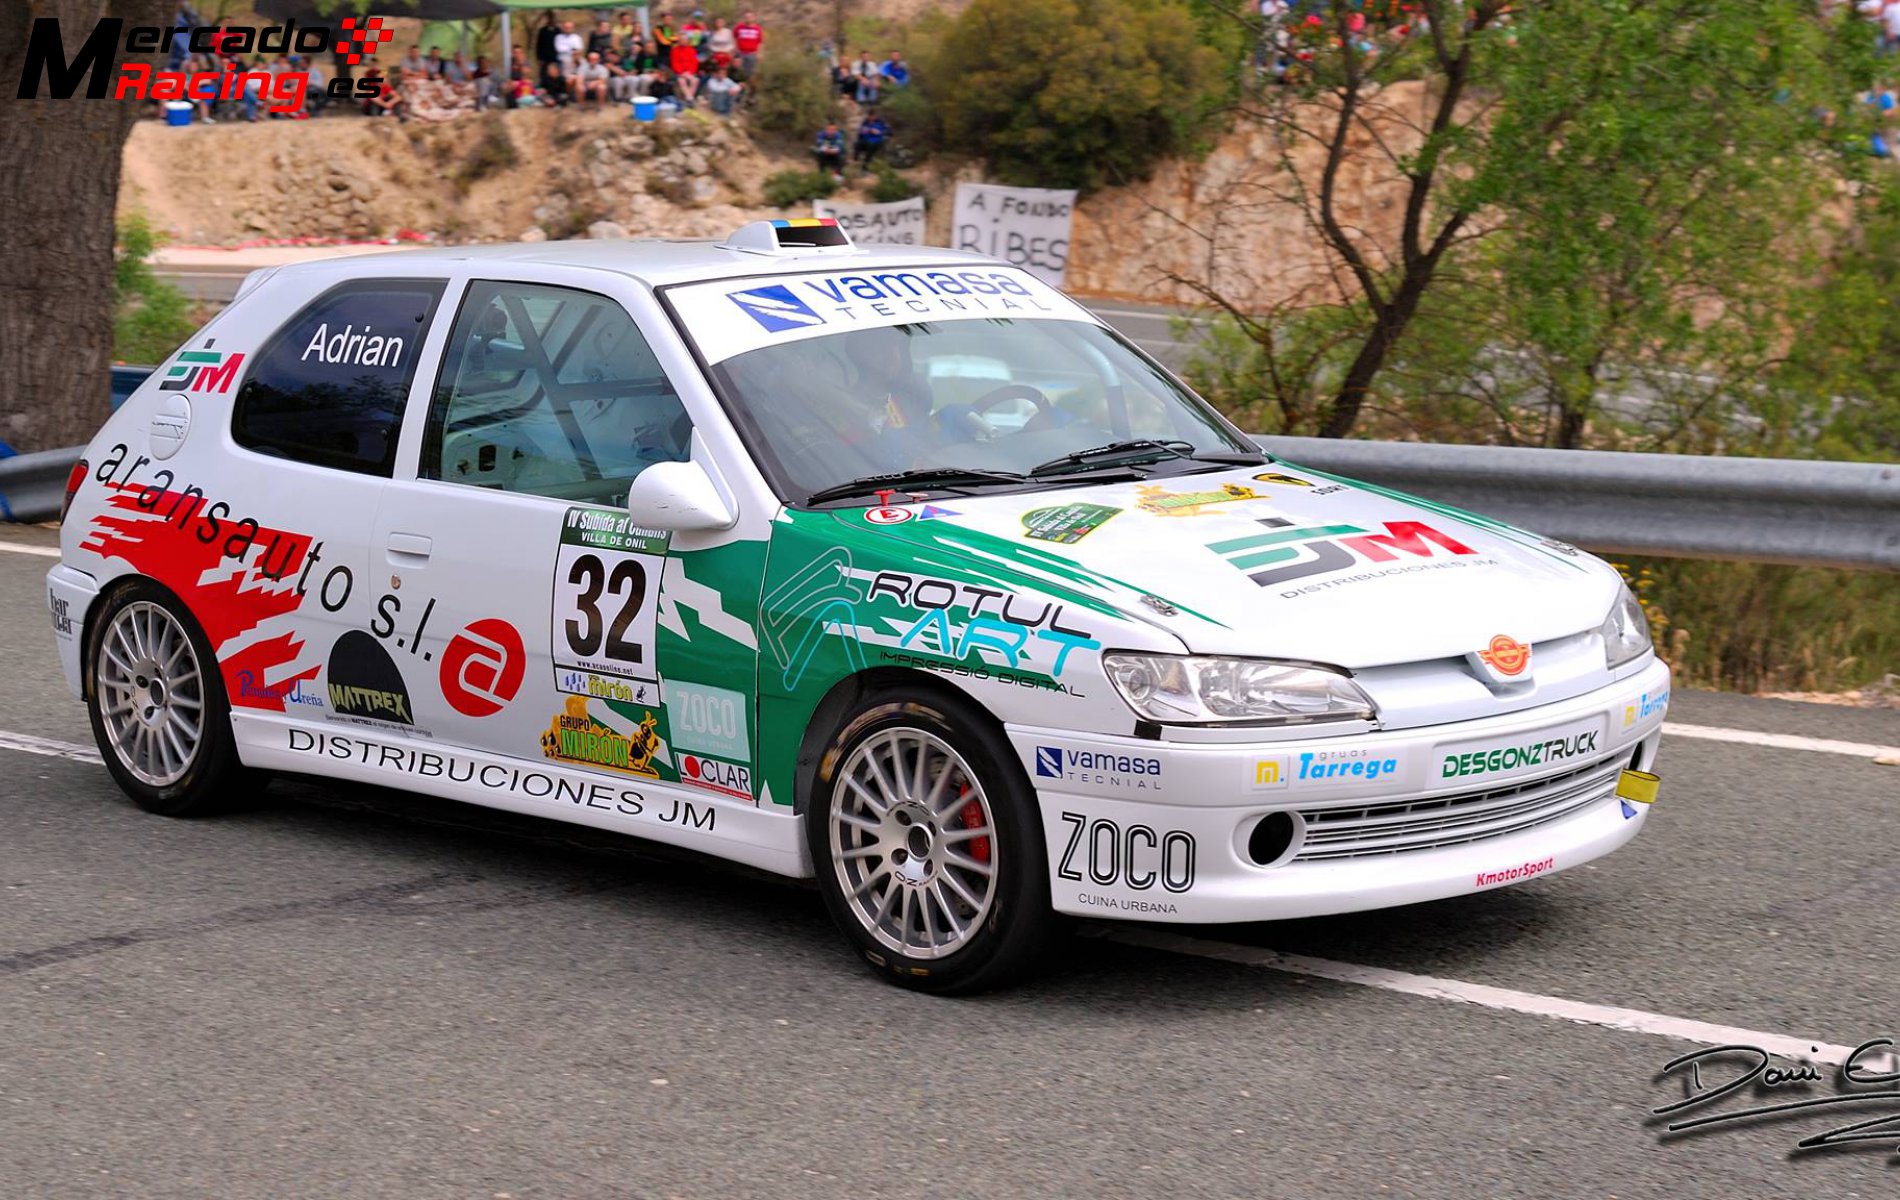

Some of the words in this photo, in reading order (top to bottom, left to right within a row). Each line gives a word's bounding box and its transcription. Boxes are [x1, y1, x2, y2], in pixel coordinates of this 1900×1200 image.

[803, 271, 1033, 304] vamasa
[834, 297, 1053, 321] TECNIAL
[302, 323, 403, 367] Adrian
[567, 510, 582, 528] IV
[580, 511, 616, 533] Subida
[95, 443, 353, 612] aransauto
[371, 594, 436, 662] s.l.
[581, 531, 607, 544] VILLA
[609, 535, 623, 546] DE
[625, 537, 647, 549] ONIL
[1280, 561, 1466, 599] DISTRIBUCIONES
[564, 553, 647, 664] 32
[868, 572, 1092, 639] ROTUL
[901, 608, 1101, 677] ART
[998, 673, 1085, 698] DIGITAL
[328, 682, 413, 725] MATTREX
[677, 690, 737, 738] ZOCO
[560, 715, 590, 731] GRUPO
[1067, 749, 1161, 776] vamasa
[1299, 752, 1398, 780] Tarrega
[1442, 730, 1599, 778] DESGONZTRUCK
[288, 728, 645, 816] DISTRIBUCIONES
[658, 800, 717, 832] JM
[1067, 771, 1162, 790] TECNIAL
[1058, 811, 1196, 894] ZOCO
[1476, 857, 1554, 887] KmotorSport
[1078, 893, 1118, 909] CUINA
[1121, 900, 1178, 914] URBANA
